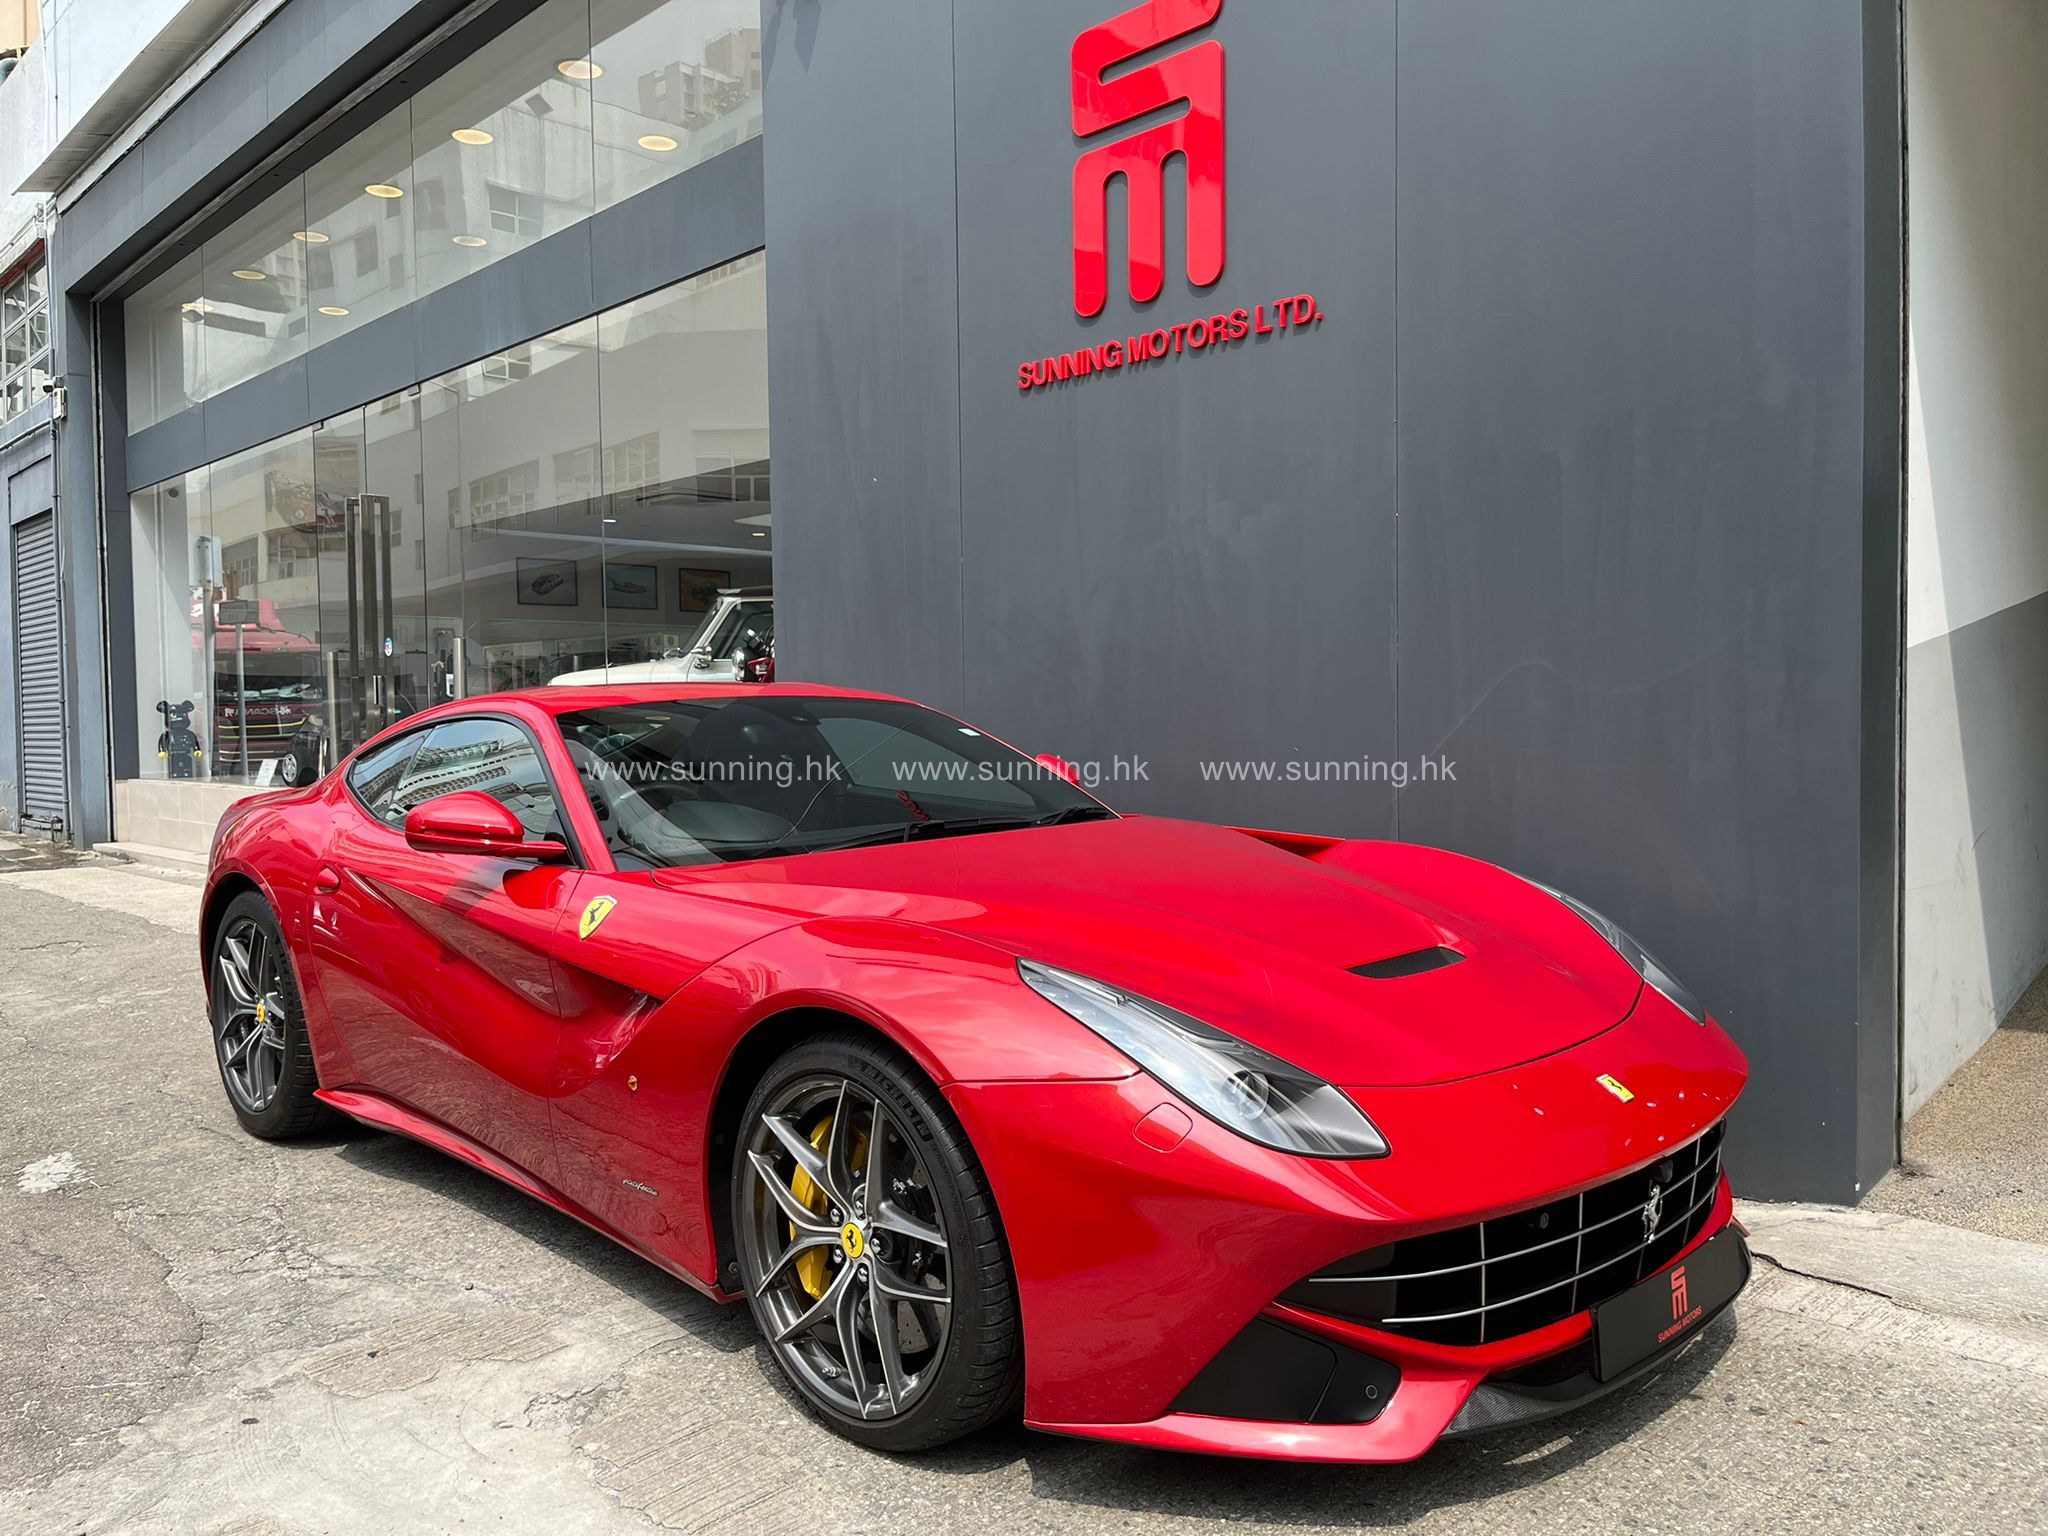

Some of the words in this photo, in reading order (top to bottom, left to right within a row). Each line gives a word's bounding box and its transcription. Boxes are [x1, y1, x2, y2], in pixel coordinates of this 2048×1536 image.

[1018, 340, 1123, 390] SUNNING
[1127, 309, 1249, 364] MOTORS
[1255, 294, 1324, 335] LTD.
[863, 1064, 934, 1142] MICHELIN
[1657, 1320, 1681, 1343] SUNNING
[1682, 1305, 1702, 1327] MOTORS
